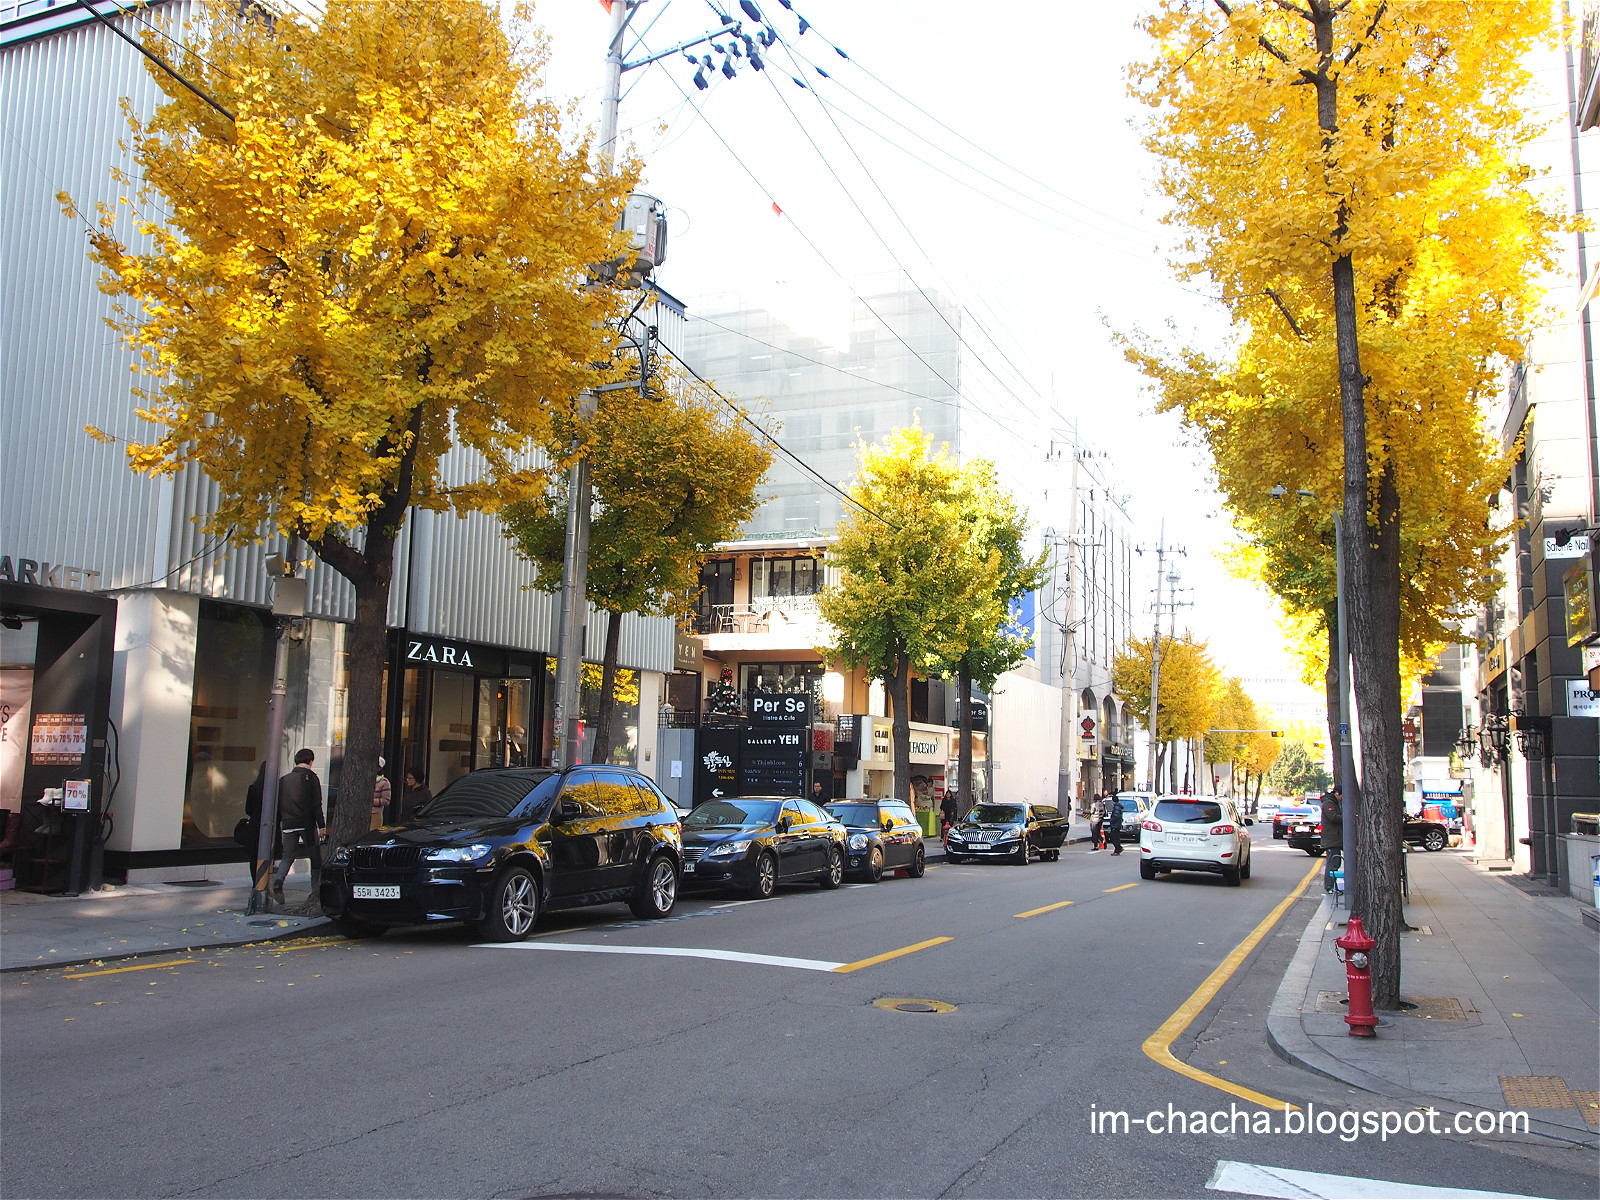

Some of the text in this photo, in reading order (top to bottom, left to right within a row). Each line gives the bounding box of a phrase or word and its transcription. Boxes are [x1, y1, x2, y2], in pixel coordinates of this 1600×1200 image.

[0, 555, 100, 593] ARKET
[407, 641, 474, 667] ZARA
[753, 698, 806, 712] Per Se
[779, 734, 799, 745] YEH
[909, 742, 938, 754] FACESHOP
[67, 789, 87, 799] 70%
[374, 887, 396, 898] 3423
